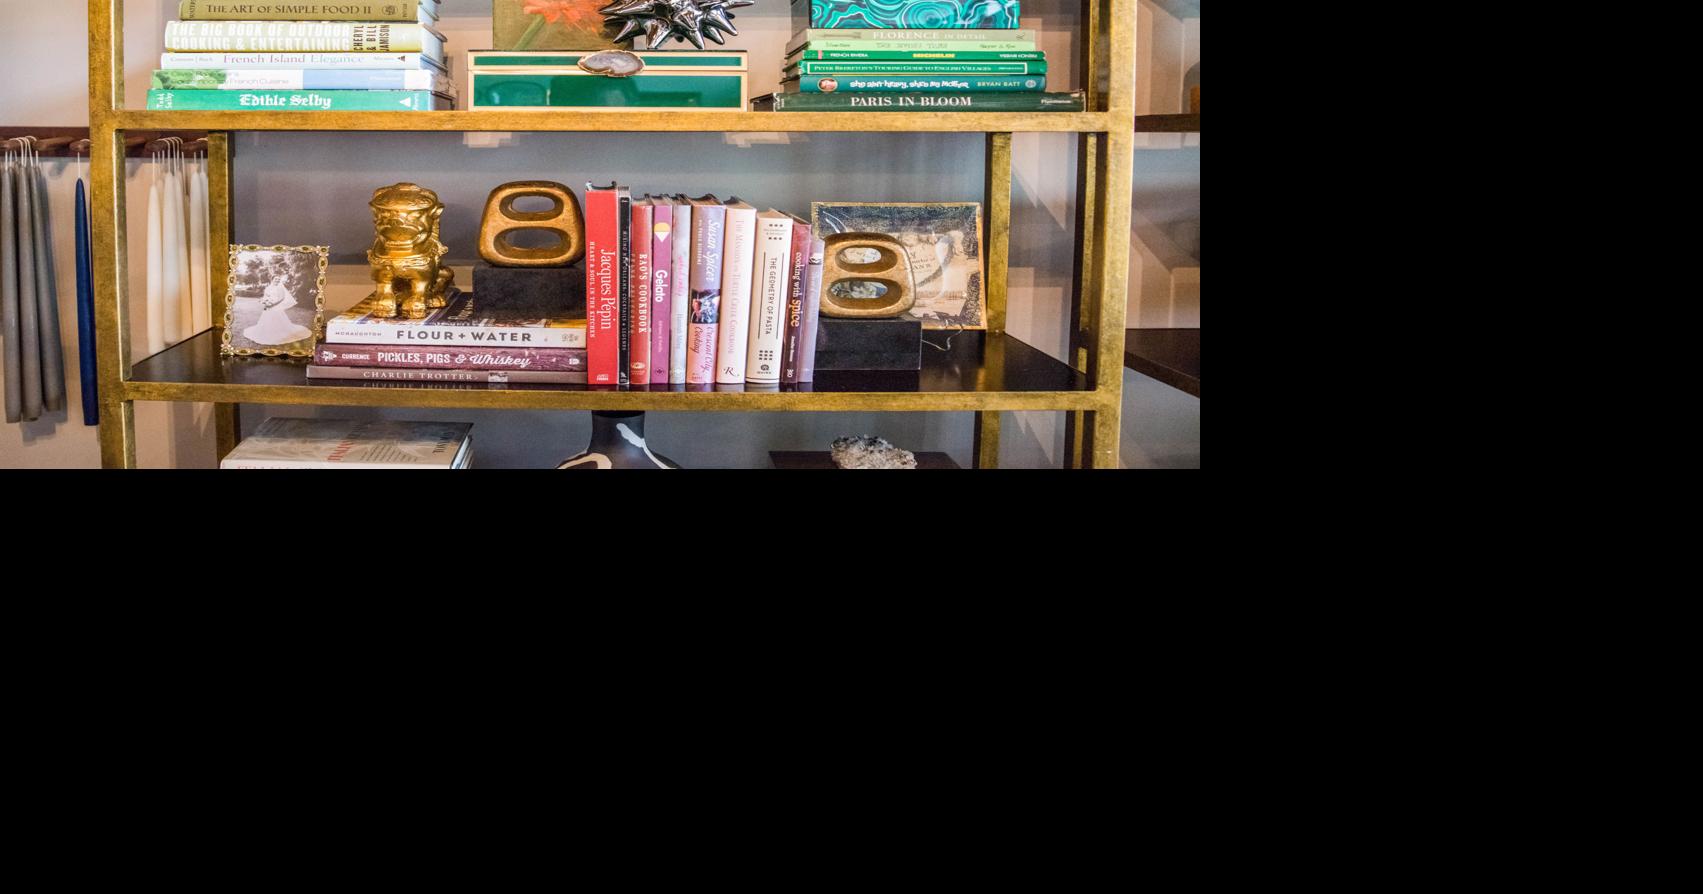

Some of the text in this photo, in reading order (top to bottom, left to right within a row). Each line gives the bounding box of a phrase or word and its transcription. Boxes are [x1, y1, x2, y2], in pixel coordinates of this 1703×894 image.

[207, 4, 372, 14] THE ART OF SIMPLE FOOD II
[172, 23, 350, 37] THE BIG BOOK OF OUTDOOR
[353, 25, 364, 51] CHERYL
[366, 25, 377, 42] BILL
[379, 24, 390, 52] JAMISON
[873, 31, 939, 40] FLORENCE
[172, 37, 350, 51] COOKING & ENTERTAINING
[223, 54, 264, 64] French
[269, 54, 306, 64] Island
[310, 54, 366, 65] Elegance
[239, 93, 332, 108] Edible Selby
[851, 96, 972, 106] PARIS IN BLOOM
[702, 219, 719, 282] Susan Spicer
[792, 252, 805, 281] cooking
[589, 287, 596, 295] IN
[596, 249, 616, 330] Jacques Pépin
[638, 253, 648, 334] RAO'S COOKBOOK
[654, 269, 669, 303] Gelato
[792, 281, 803, 298] with
[764, 257, 778, 335] THE GEOMETRY OF PASTA
[788, 299, 803, 327] spice
[396, 330, 454, 341] FLOUR
[471, 332, 532, 342] WATER
[690, 326, 703, 354] Cooking
[700, 326, 714, 374] Crescent City
[341, 351, 532, 368] CURRENCE PICKLES, PIGS & Whiskey
[363, 371, 414, 379] CHARLIE
